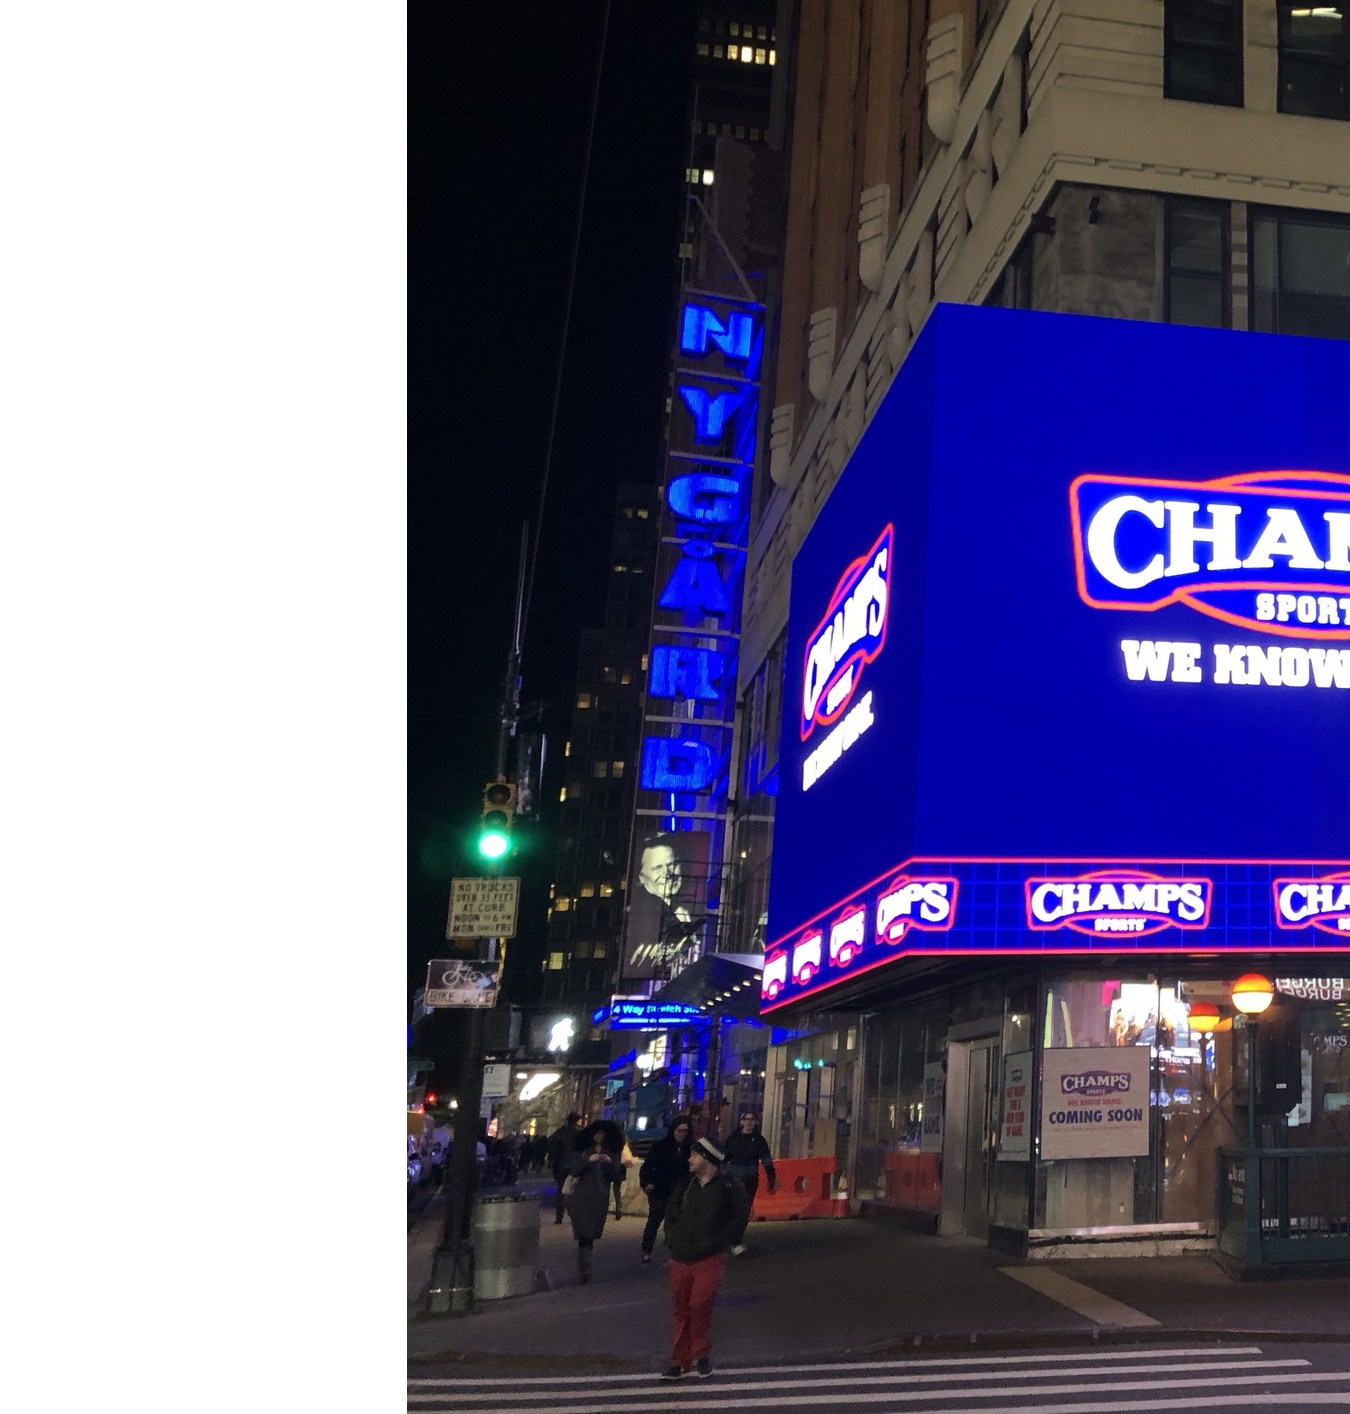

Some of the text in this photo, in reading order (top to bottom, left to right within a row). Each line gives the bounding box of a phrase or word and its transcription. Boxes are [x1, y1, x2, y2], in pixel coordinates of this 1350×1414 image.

[1121, 640, 1202, 683] WE
[476, 883, 514, 892] TRUCKS
[1031, 883, 1204, 922] CHAMPS
[1094, 918, 1146, 931] SPORTS
[623, 1005, 644, 1016] Way
[1063, 1074, 1129, 1092] CHAMPS
[1049, 1108, 1143, 1124] COMING SOON
